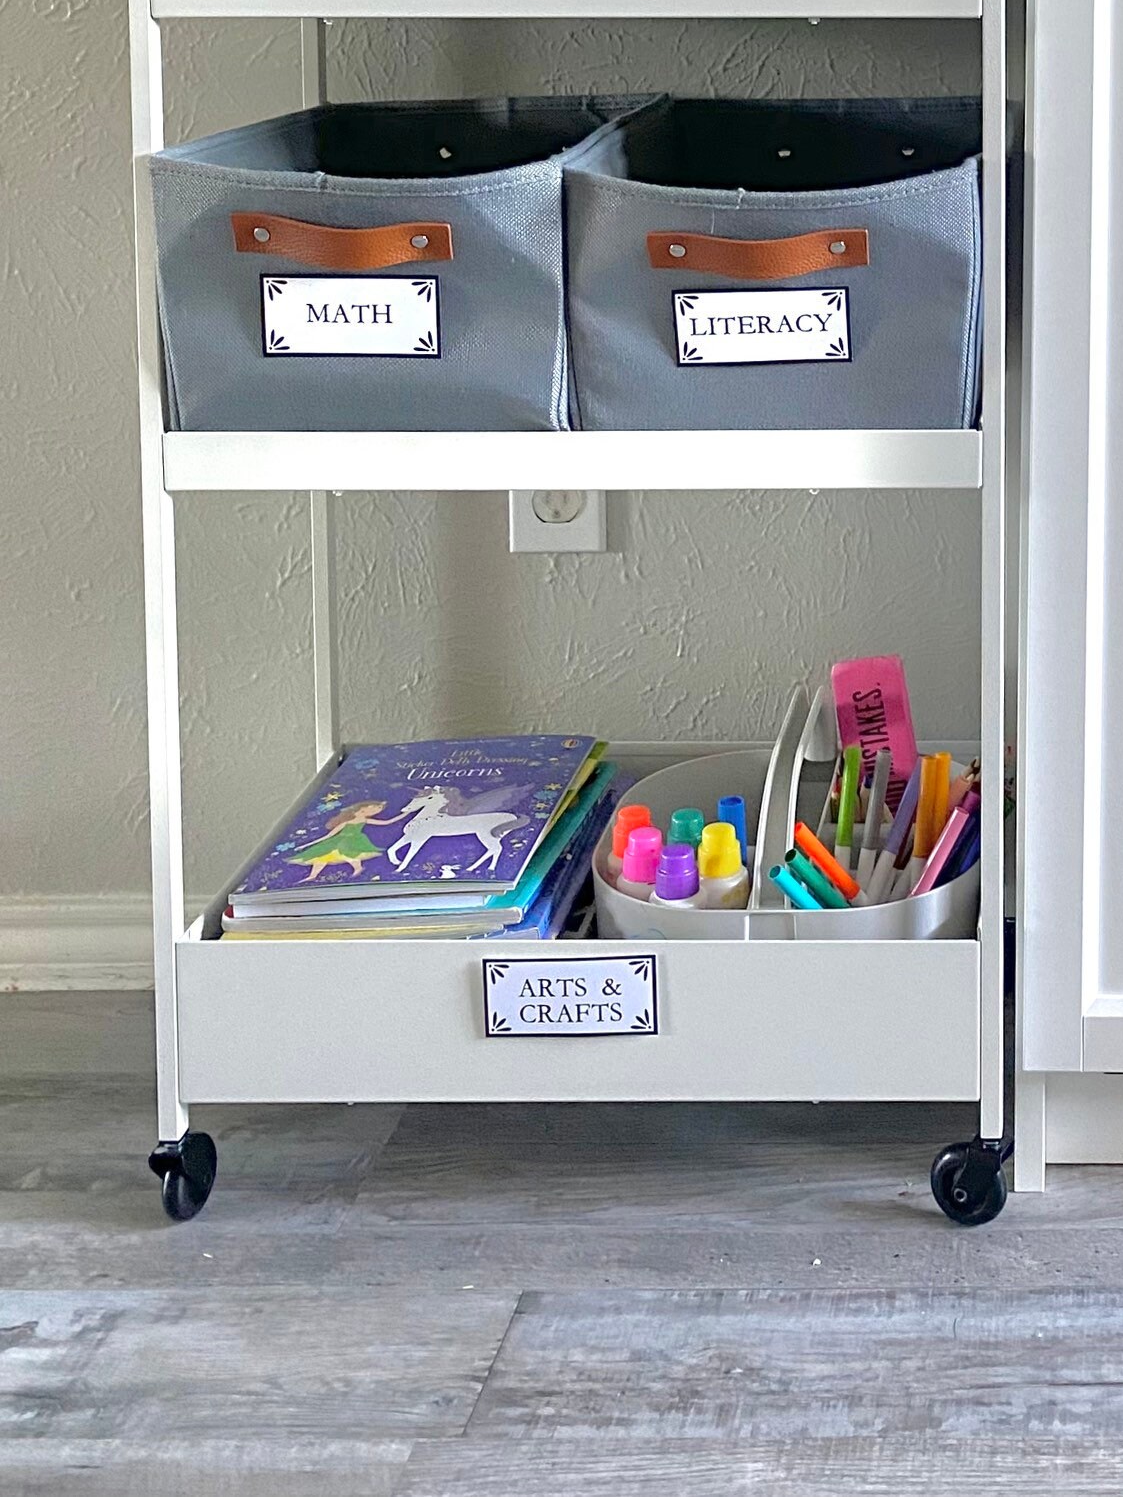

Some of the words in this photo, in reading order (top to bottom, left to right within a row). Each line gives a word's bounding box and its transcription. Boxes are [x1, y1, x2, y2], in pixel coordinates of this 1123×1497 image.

[306, 304, 392, 323] MATH
[690, 314, 832, 335] LITERACY
[396, 760, 433, 770] Sticker
[476, 755, 529, 765] Dressing
[407, 767, 505, 781] Unicorns
[520, 978, 586, 997] ARTS
[602, 979, 621, 995] &
[520, 1003, 622, 1023] CRAFTS
